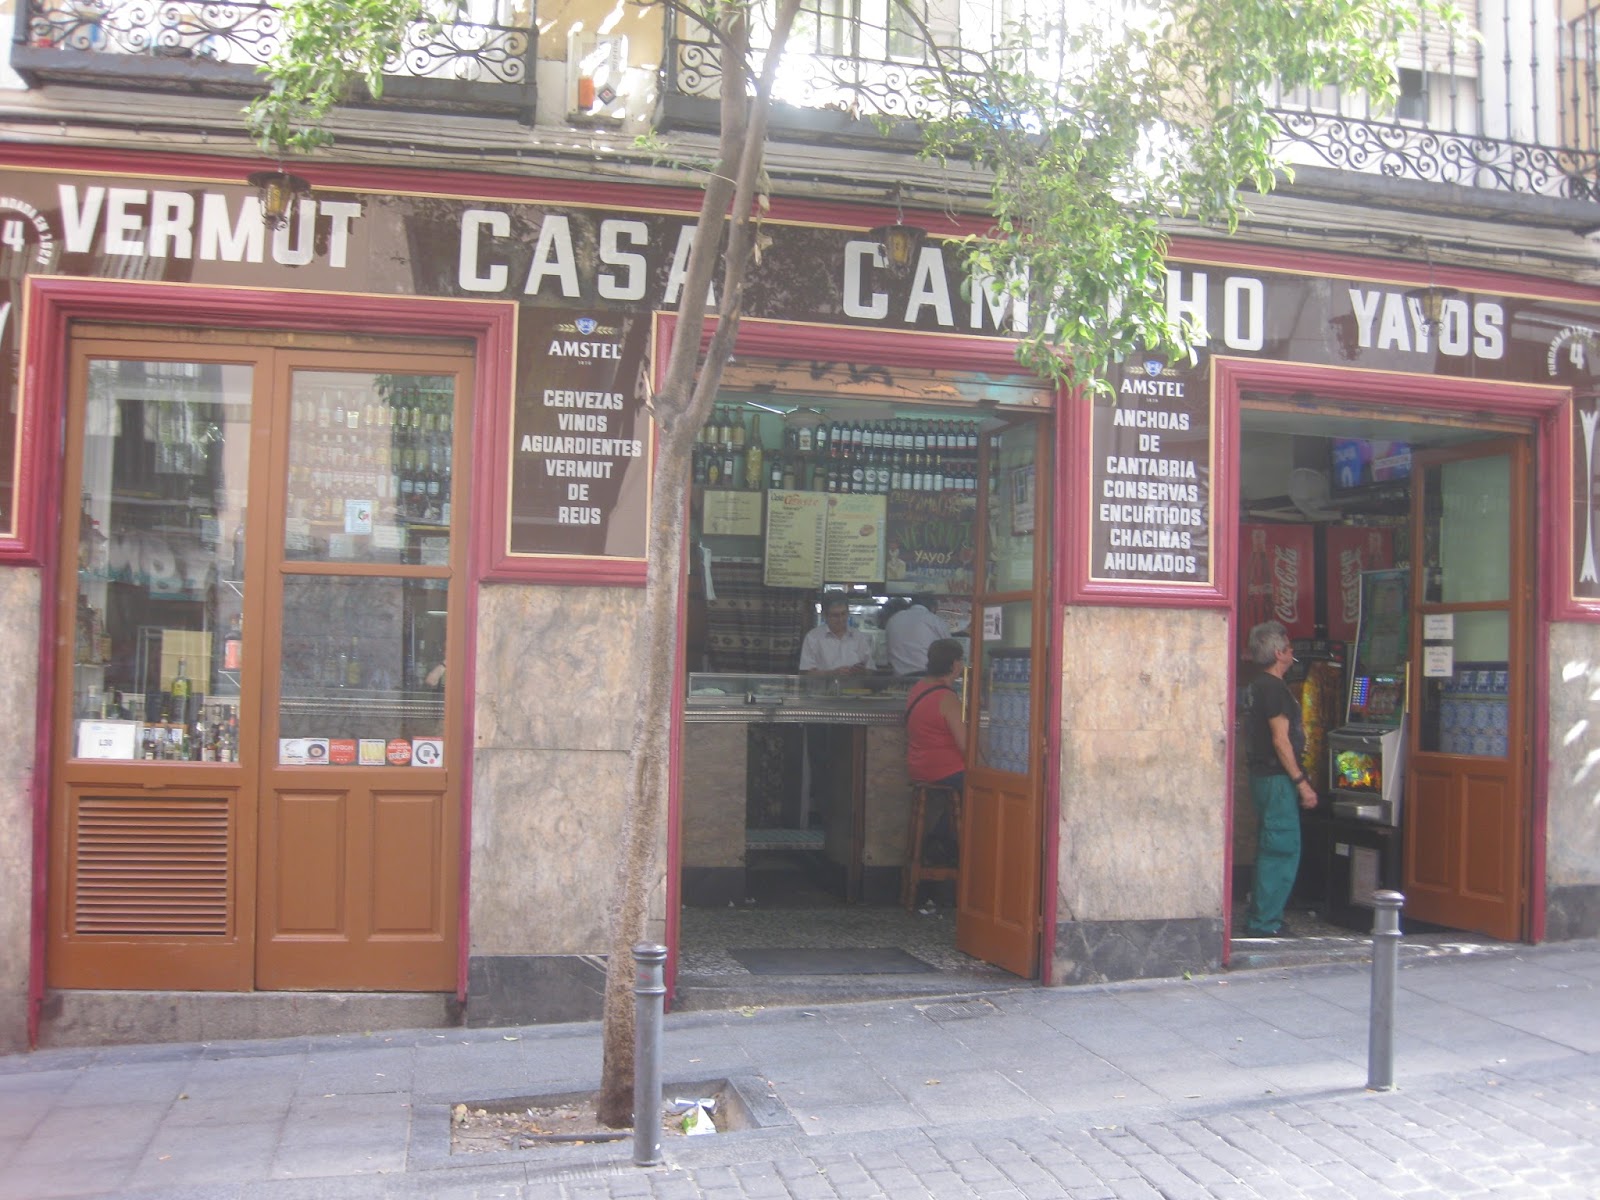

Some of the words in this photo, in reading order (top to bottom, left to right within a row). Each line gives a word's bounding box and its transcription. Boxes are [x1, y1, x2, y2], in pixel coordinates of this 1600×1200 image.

[3, 219, 25, 252] 4
[58, 184, 362, 268] VERMUT
[842, 240, 1264, 351] CAMHO
[1348, 289, 1504, 359] YAYOS
[548, 340, 622, 359] AMSTEL
[1570, 343, 1584, 369] 4
[1120, 378, 1184, 398] AMSTEL
[543, 389, 624, 410] CERVEZAS
[558, 413, 608, 433] VINOS
[1113, 408, 1190, 431] ANCHOAS
[521, 435, 642, 457] AGUARDIENTES
[1138, 434, 1160, 452] DE
[545, 459, 613, 479] VERMUT
[1106, 456, 1196, 479] CANTABRIA
[568, 483, 589, 501] DE
[1103, 480, 1198, 502] CONSERVAS
[558, 506, 601, 525] REUS
[1099, 503, 1201, 526] ENCURTIDOS
[1110, 528, 1191, 549] CHACINAS
[914, 549, 955, 565] YAYOS
[1104, 552, 1196, 574] AHUMADOS
